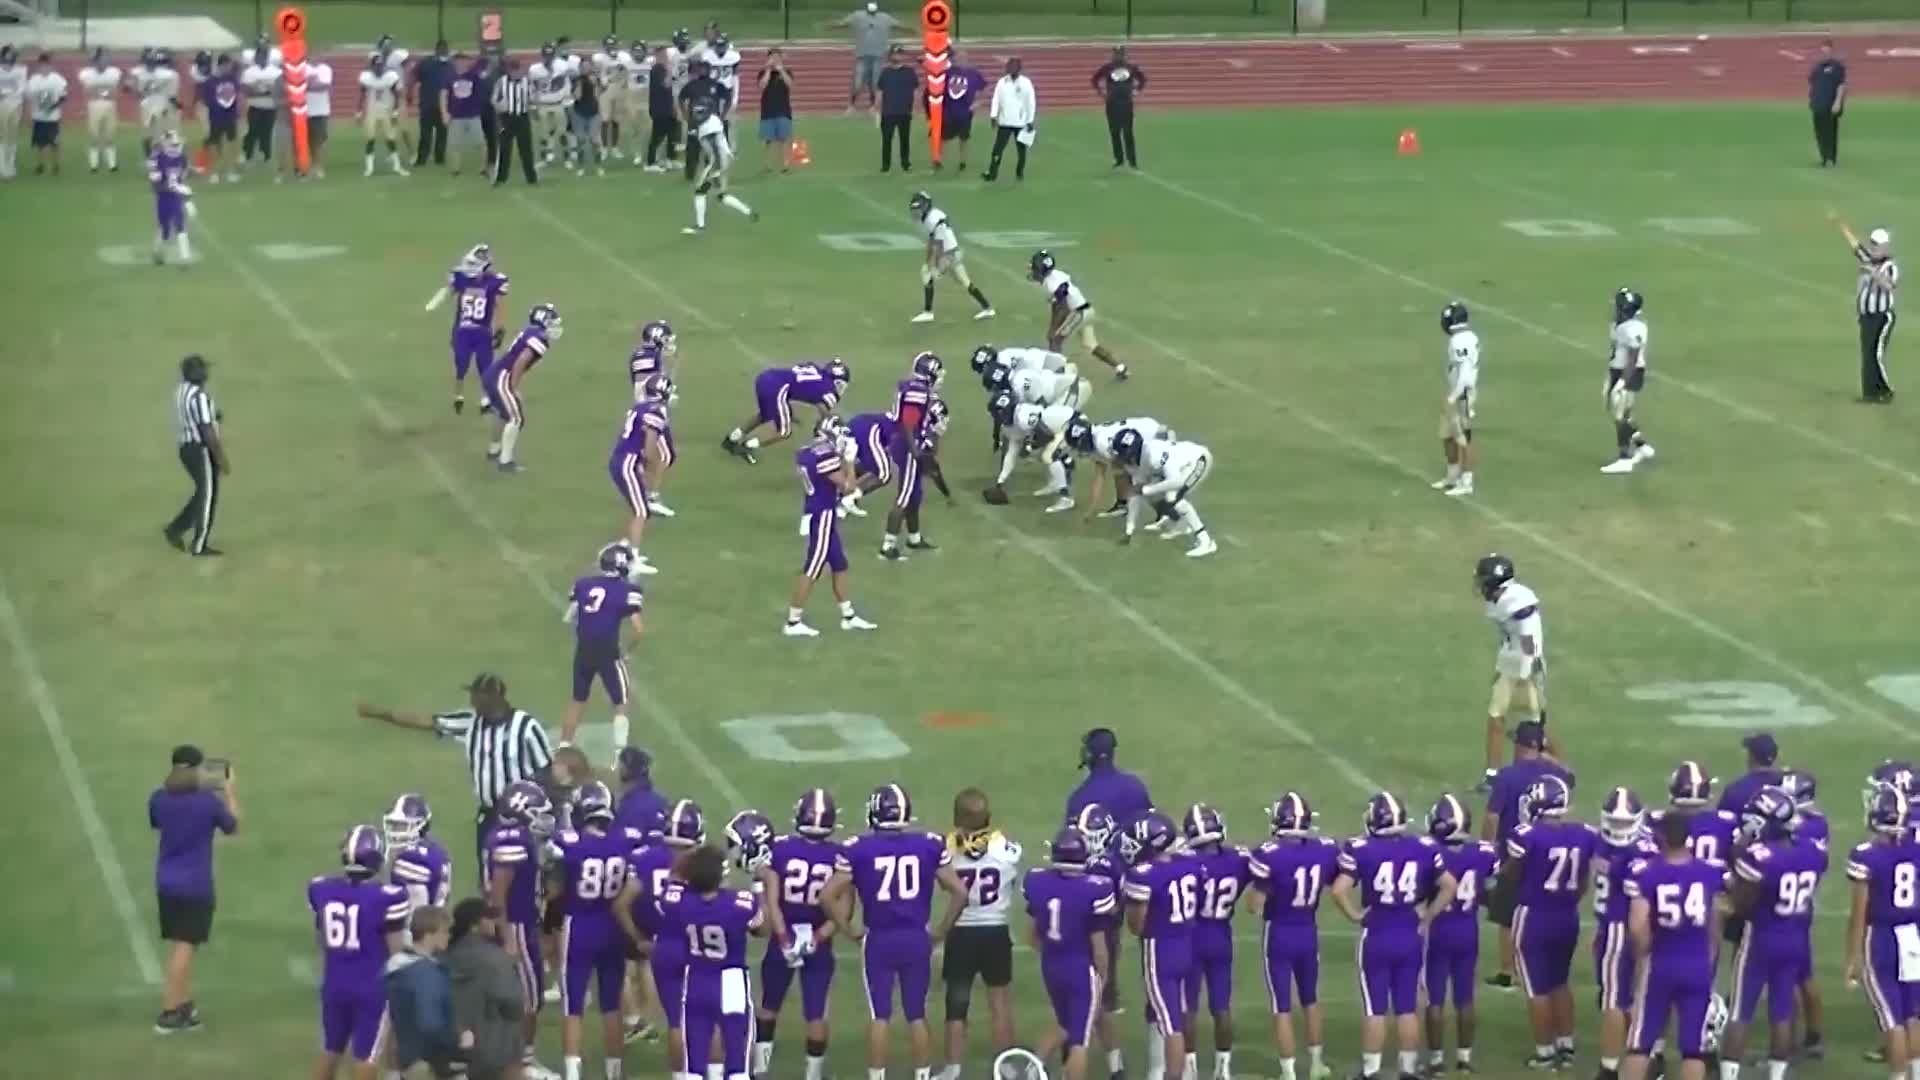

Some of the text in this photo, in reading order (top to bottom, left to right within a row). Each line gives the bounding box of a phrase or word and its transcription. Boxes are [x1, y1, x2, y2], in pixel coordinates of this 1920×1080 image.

[461, 296, 487, 319] 58
[584, 586, 606, 613] 3
[1135, 819, 1150, 839] H
[577, 856, 626, 900] 88
[784, 858, 834, 905] 22
[874, 854, 920, 902] 70
[956, 866, 1001, 906] 72
[1290, 863, 1322, 908] 11
[1373, 860, 1418, 905] 44
[1543, 846, 1581, 891] 71
[1893, 862, 1916, 908] 8
[1168, 873, 1198, 924] 16
[1200, 876, 1239, 920] 12
[1656, 881, 1706, 928] 54
[1773, 869, 1817, 916] 92
[323, 901, 361, 950] 61
[685, 923, 728, 960] 19
[1047, 897, 1062, 942] 1
